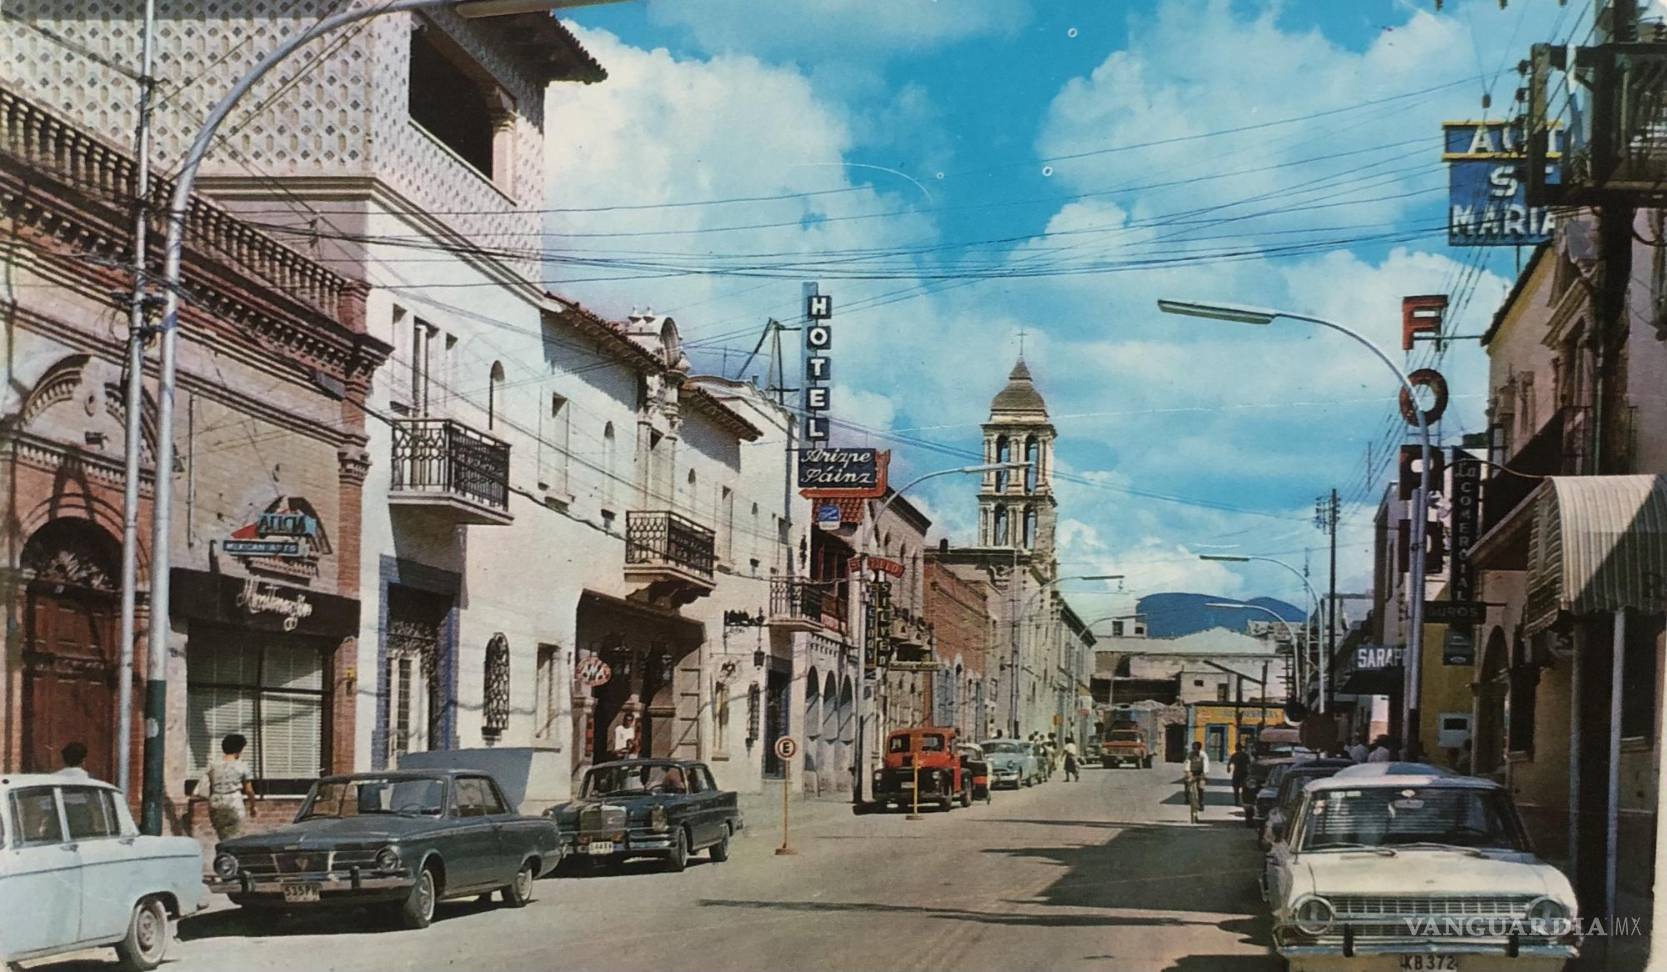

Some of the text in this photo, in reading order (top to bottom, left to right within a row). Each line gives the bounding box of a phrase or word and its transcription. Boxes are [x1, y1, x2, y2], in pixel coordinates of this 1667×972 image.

[1451, 204, 1556, 235] MARIA
[809, 297, 828, 439] HOTEL
[1397, 294, 1449, 574] FORD
[800, 448, 872, 469] Arizpe
[800, 465, 875, 484] Sáinz
[1357, 646, 1404, 669] SARAP
[781, 742, 791, 754] E
